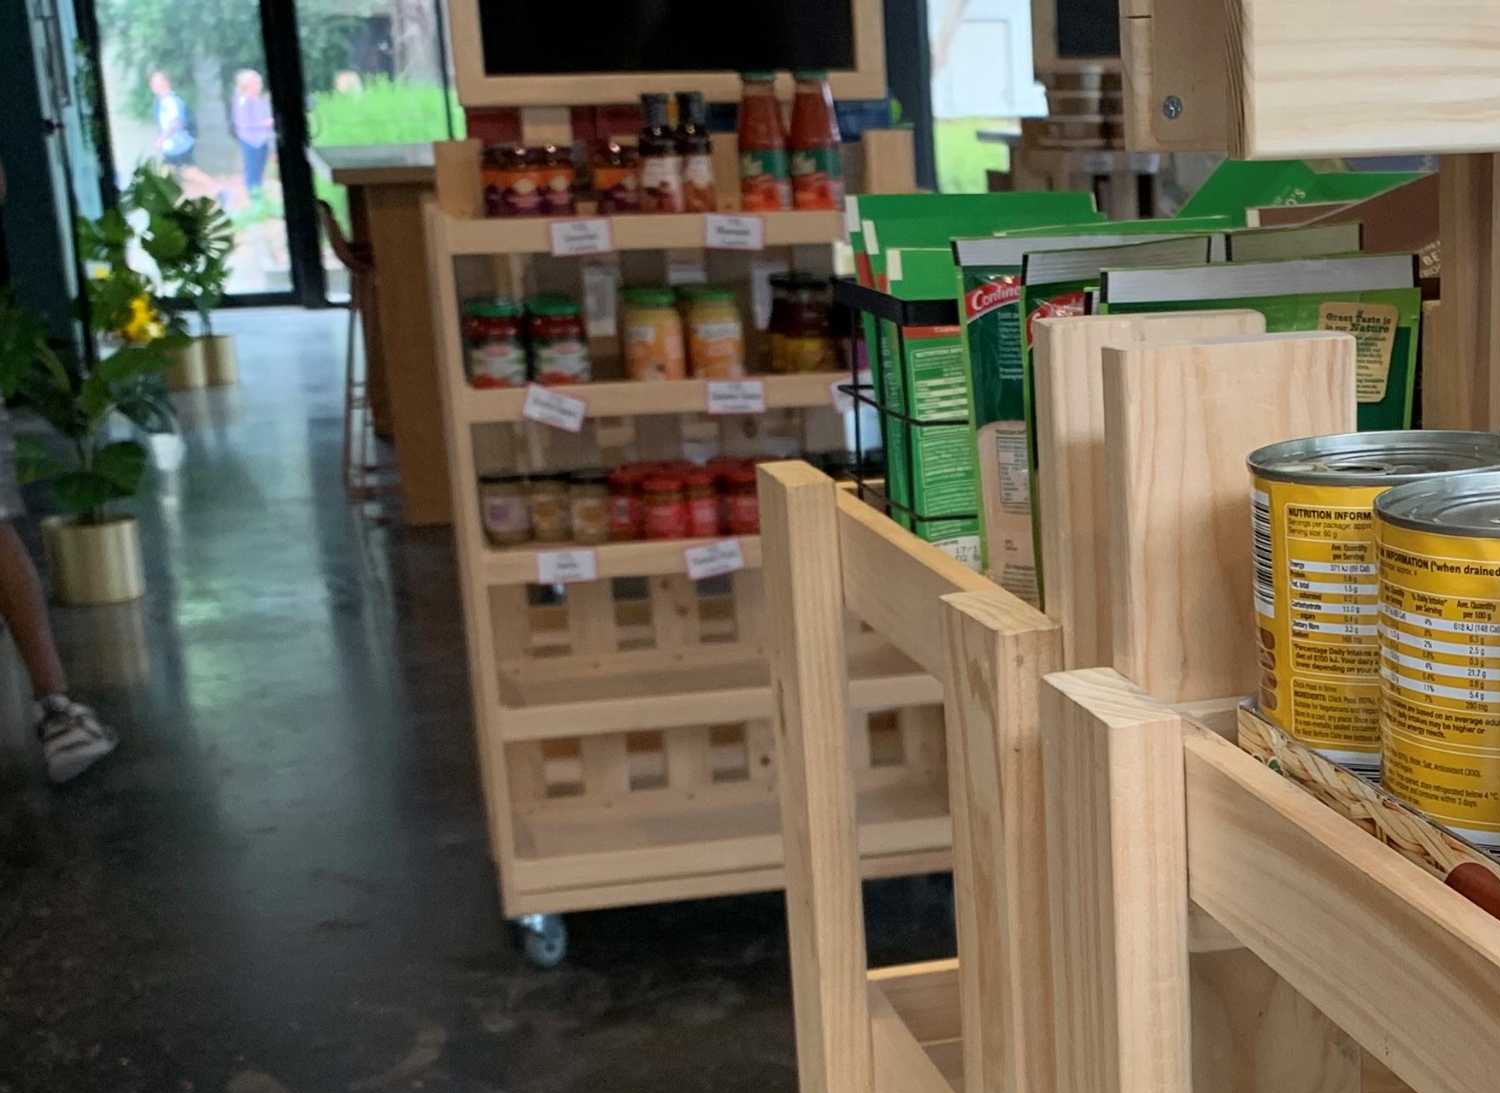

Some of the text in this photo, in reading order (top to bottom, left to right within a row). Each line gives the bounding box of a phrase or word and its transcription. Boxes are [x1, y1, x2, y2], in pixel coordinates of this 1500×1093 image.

[1350, 323, 1389, 333] Nature
[1288, 508, 1371, 520] NUTRITION INFORM
